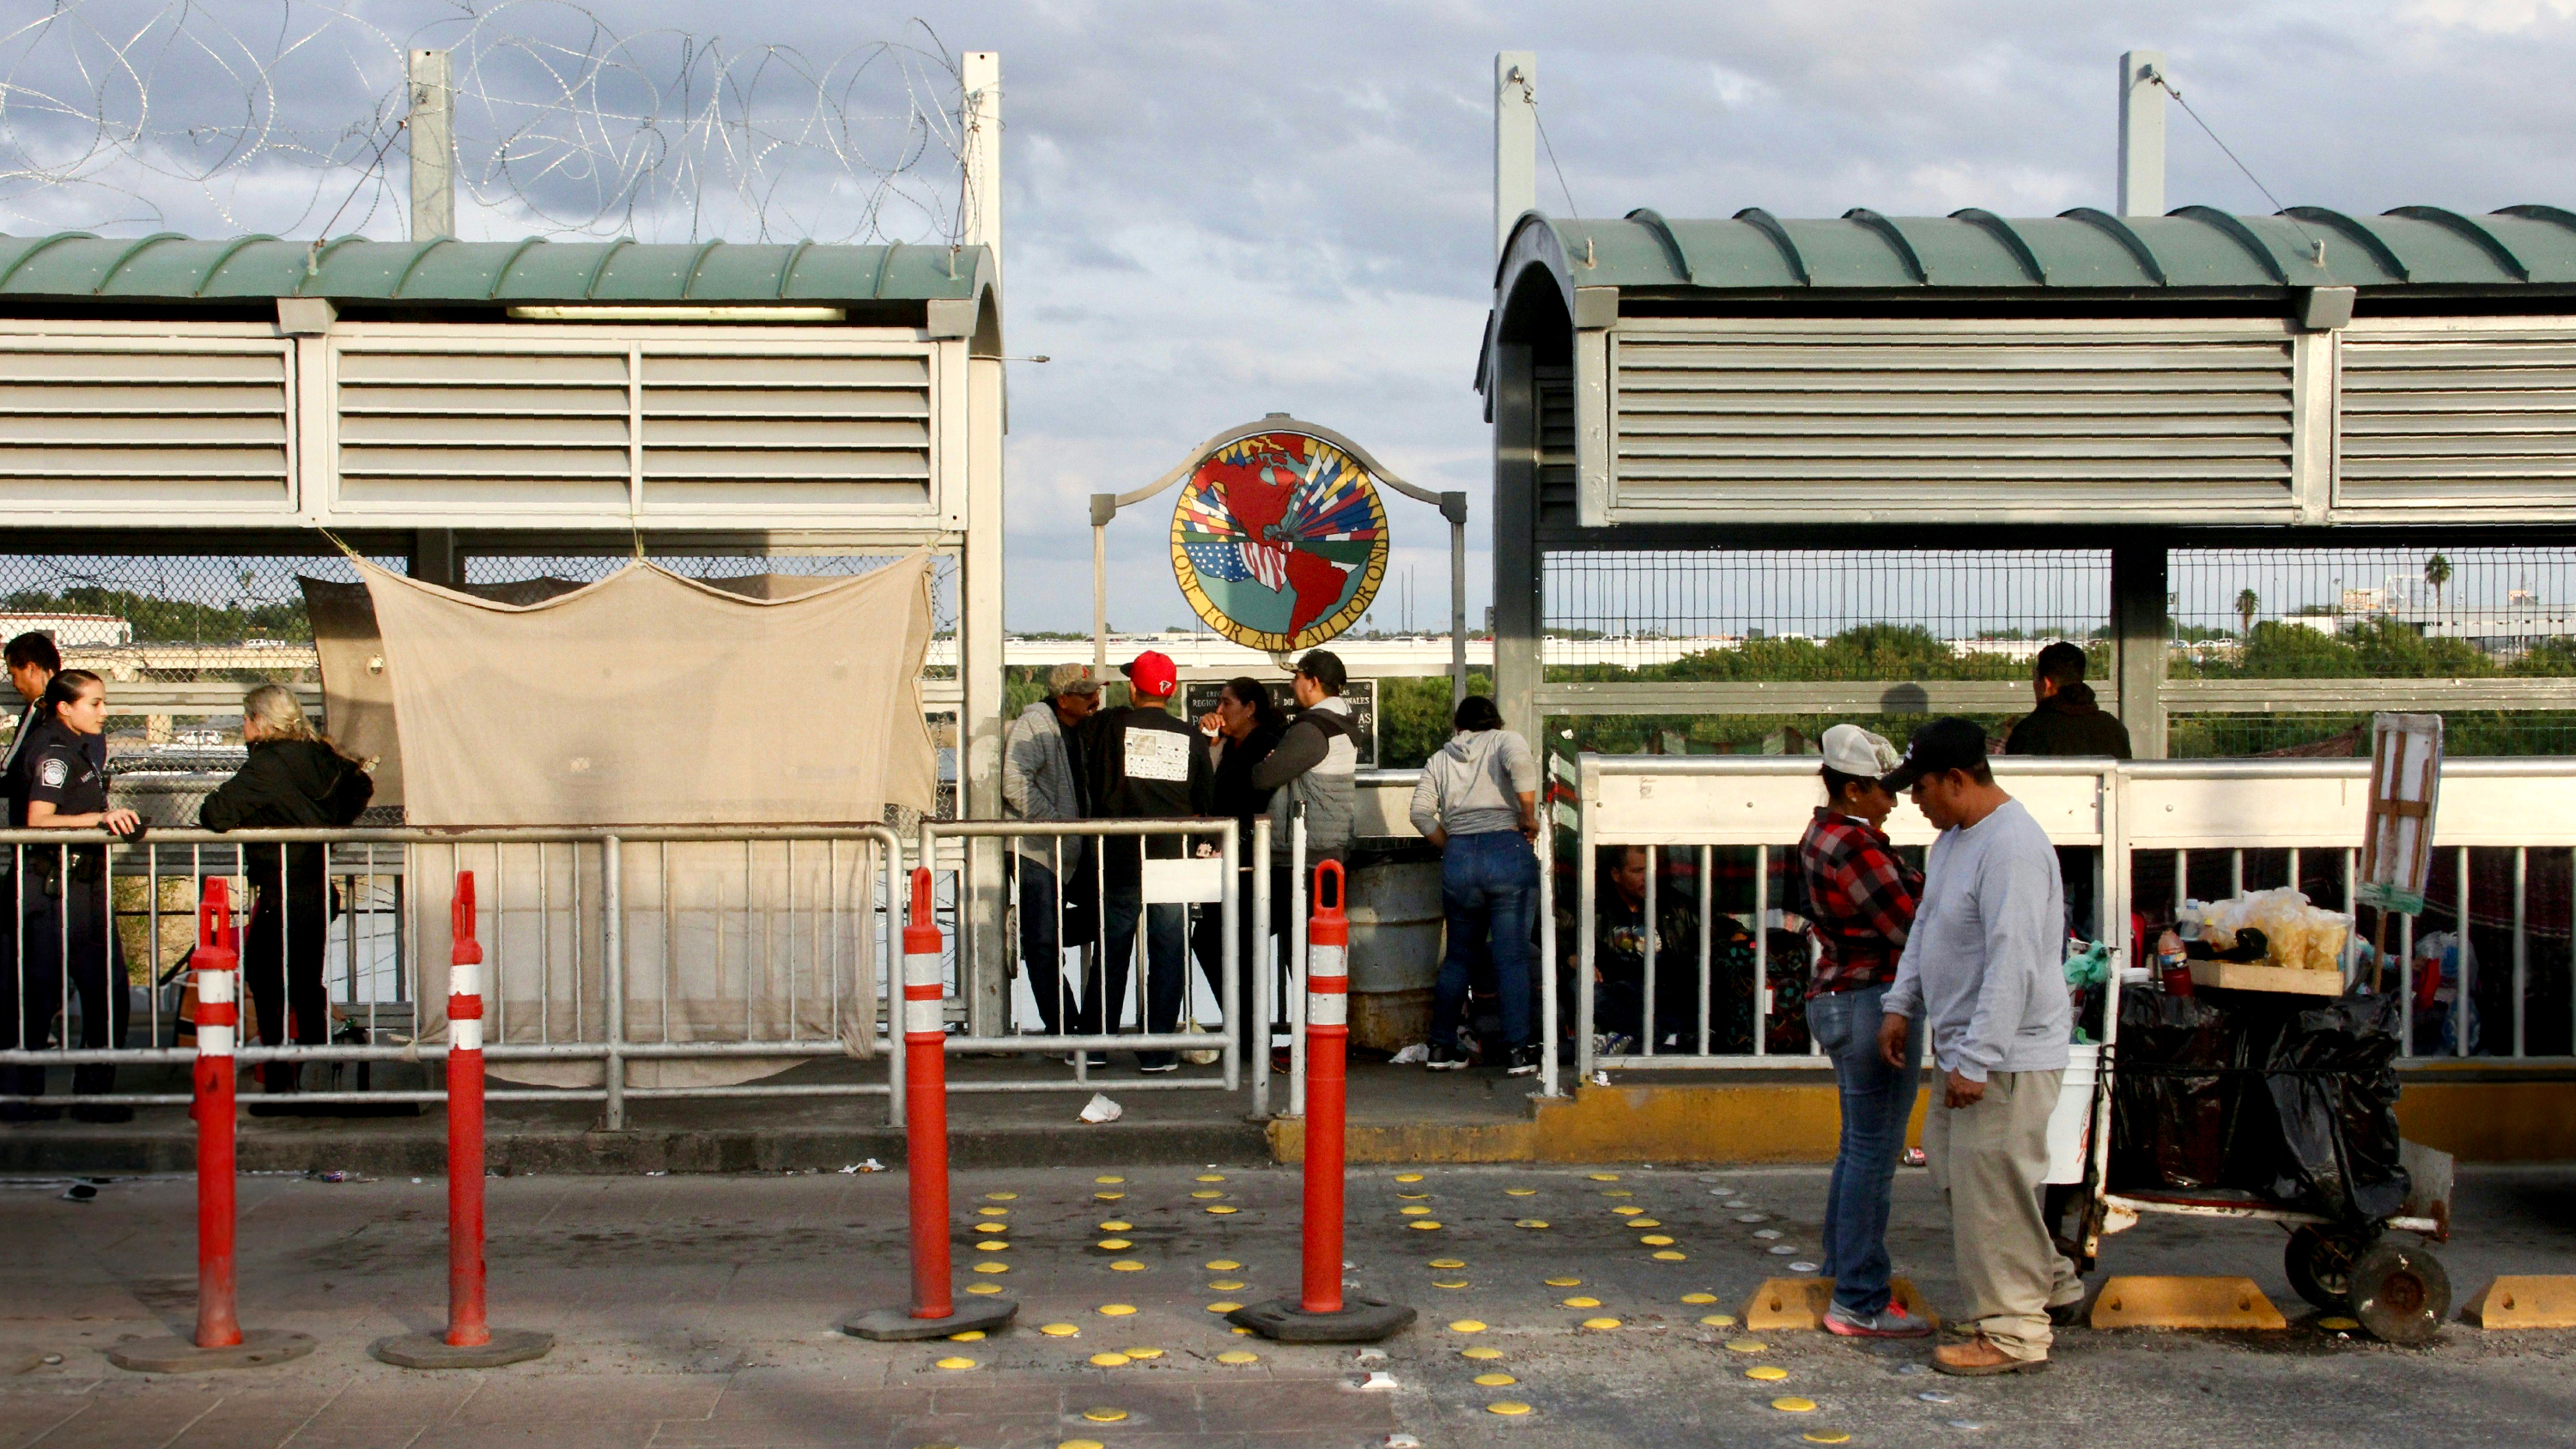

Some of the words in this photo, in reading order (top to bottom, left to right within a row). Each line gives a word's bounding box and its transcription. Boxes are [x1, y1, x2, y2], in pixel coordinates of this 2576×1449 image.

[1173, 555, 1200, 601] ONE
[1200, 603, 1242, 644] FOR
[1253, 632, 1292, 651] ALL
[1305, 621, 1344, 647] ALL
[1341, 585, 1376, 624] FOR
[1367, 538, 1388, 582] ONE
[1192, 699, 1218, 707] REGION
[1344, 696, 1370, 706] ONALES
